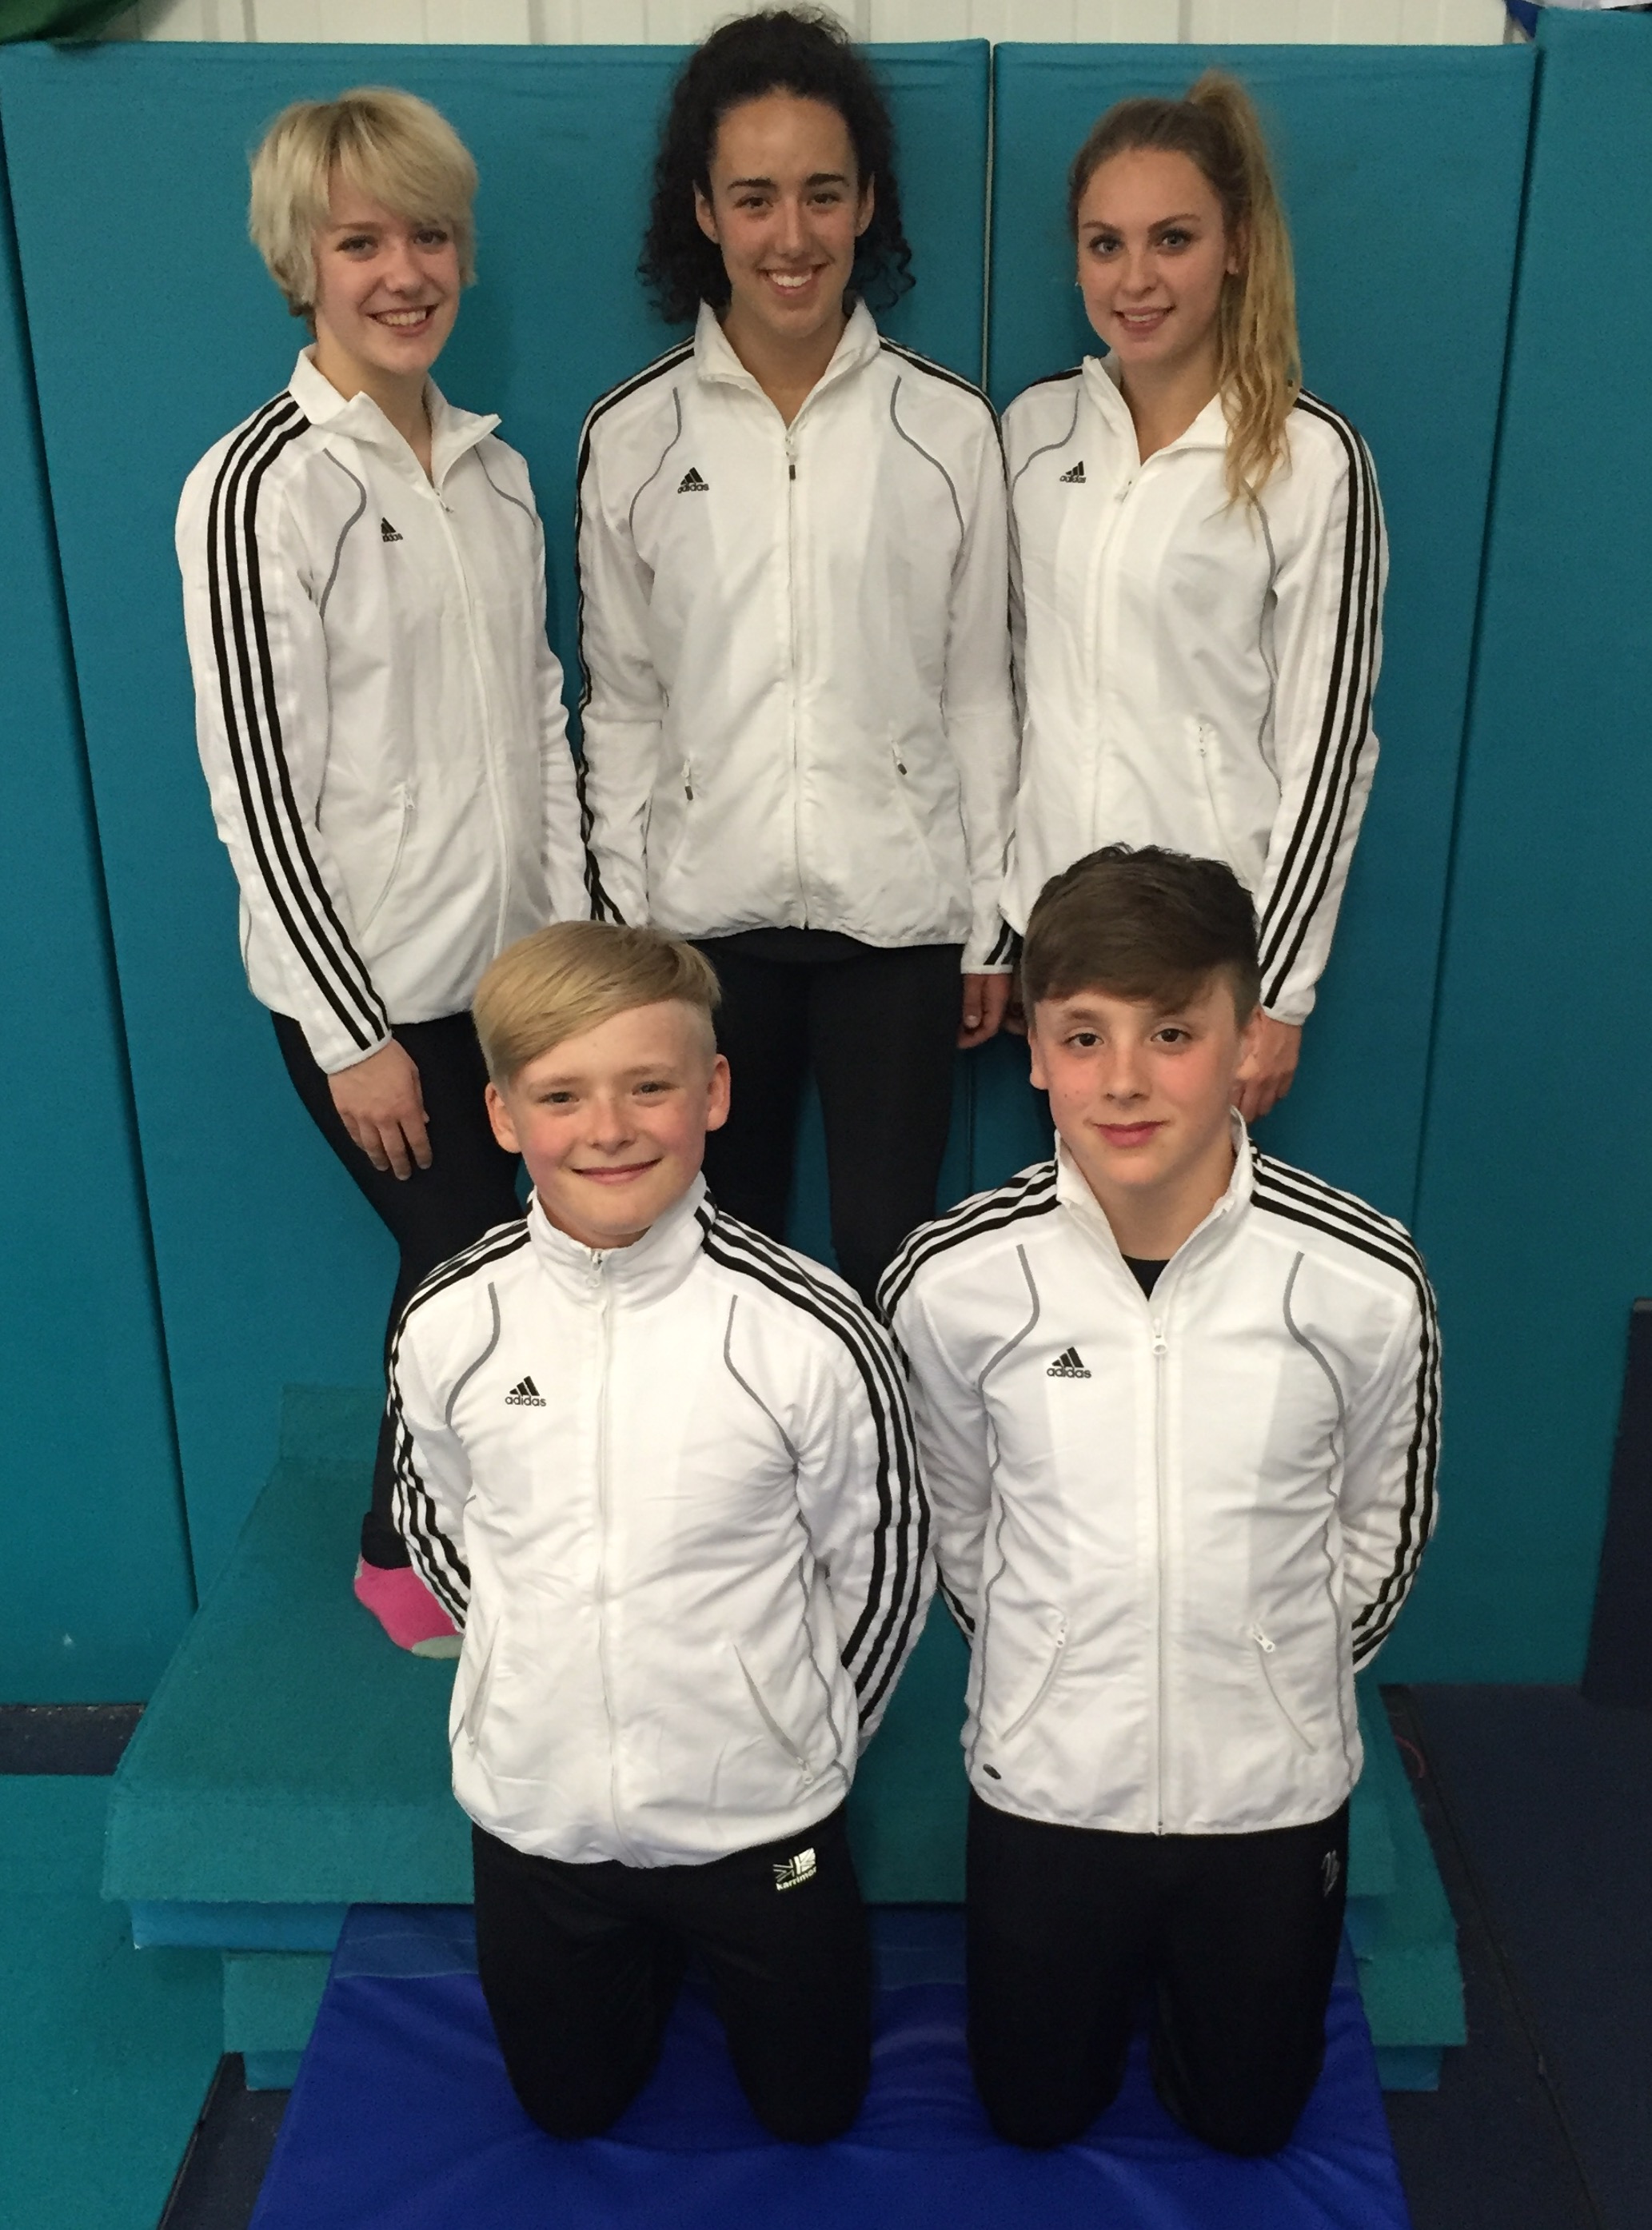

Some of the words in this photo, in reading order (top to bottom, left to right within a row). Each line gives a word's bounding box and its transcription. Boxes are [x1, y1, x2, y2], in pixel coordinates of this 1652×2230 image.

[1046, 1366, 1092, 1379] adidas
[505, 1394, 547, 1407] adidas
[776, 1865, 817, 1891] karrimor
